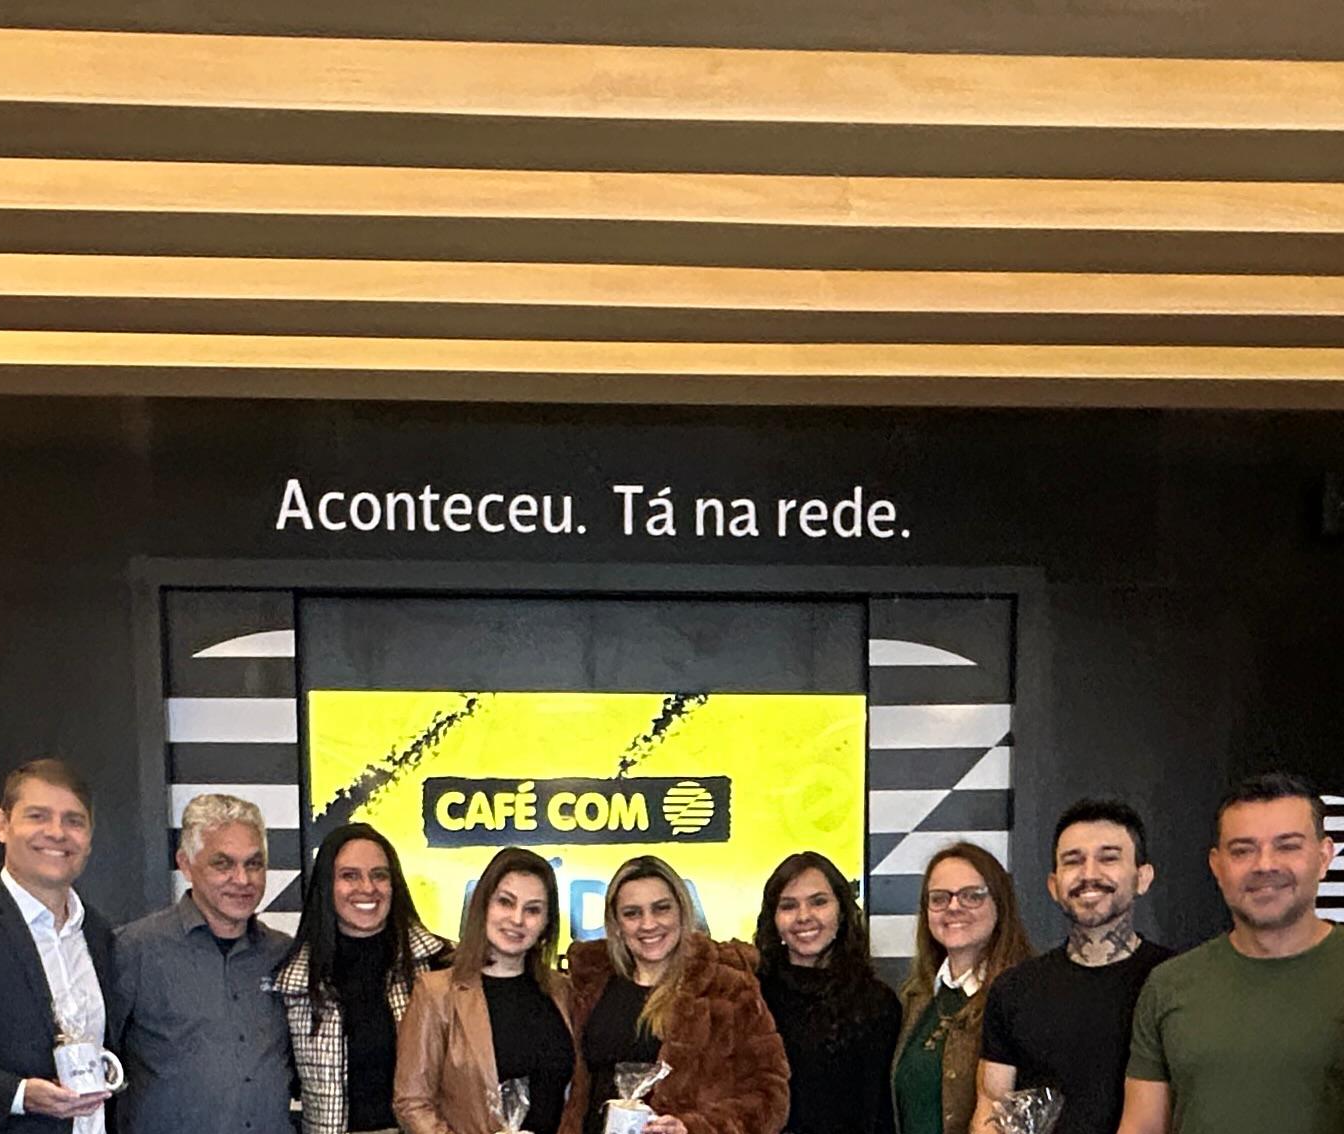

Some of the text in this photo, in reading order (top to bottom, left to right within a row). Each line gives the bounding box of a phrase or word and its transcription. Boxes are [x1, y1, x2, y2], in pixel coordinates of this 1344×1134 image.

[275, 478, 911, 538] Aconteceu. Tá na rede.
[435, 780, 651, 832] CAFÉ COM
